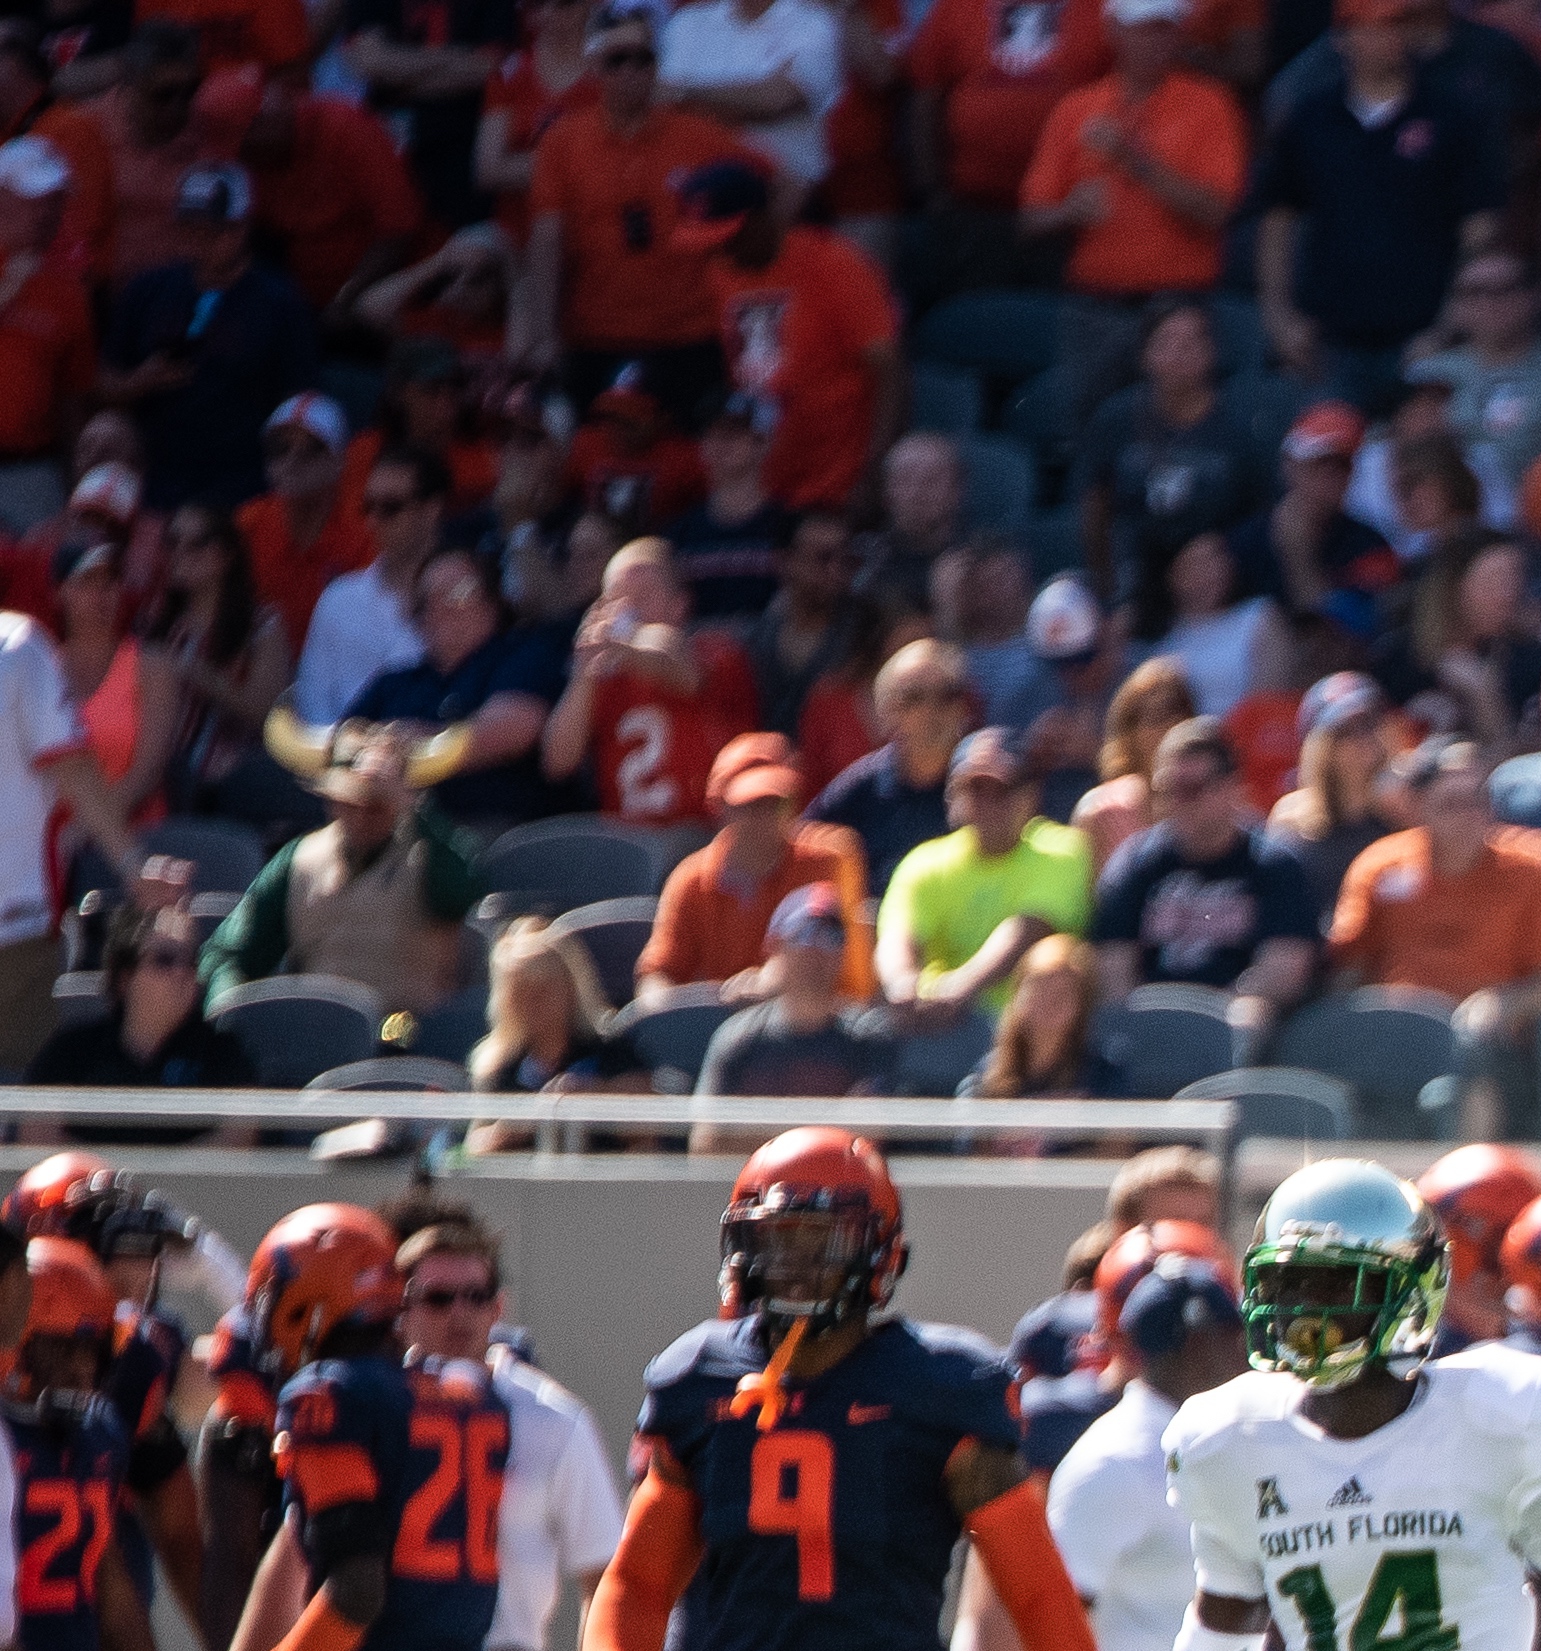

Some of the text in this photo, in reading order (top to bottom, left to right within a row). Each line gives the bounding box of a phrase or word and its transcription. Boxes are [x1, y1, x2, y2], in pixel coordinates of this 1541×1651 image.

[393, 1411, 509, 1584] 26
[748, 1429, 836, 1602] 9
[1348, 1507, 1465, 1545] FLORIDA
